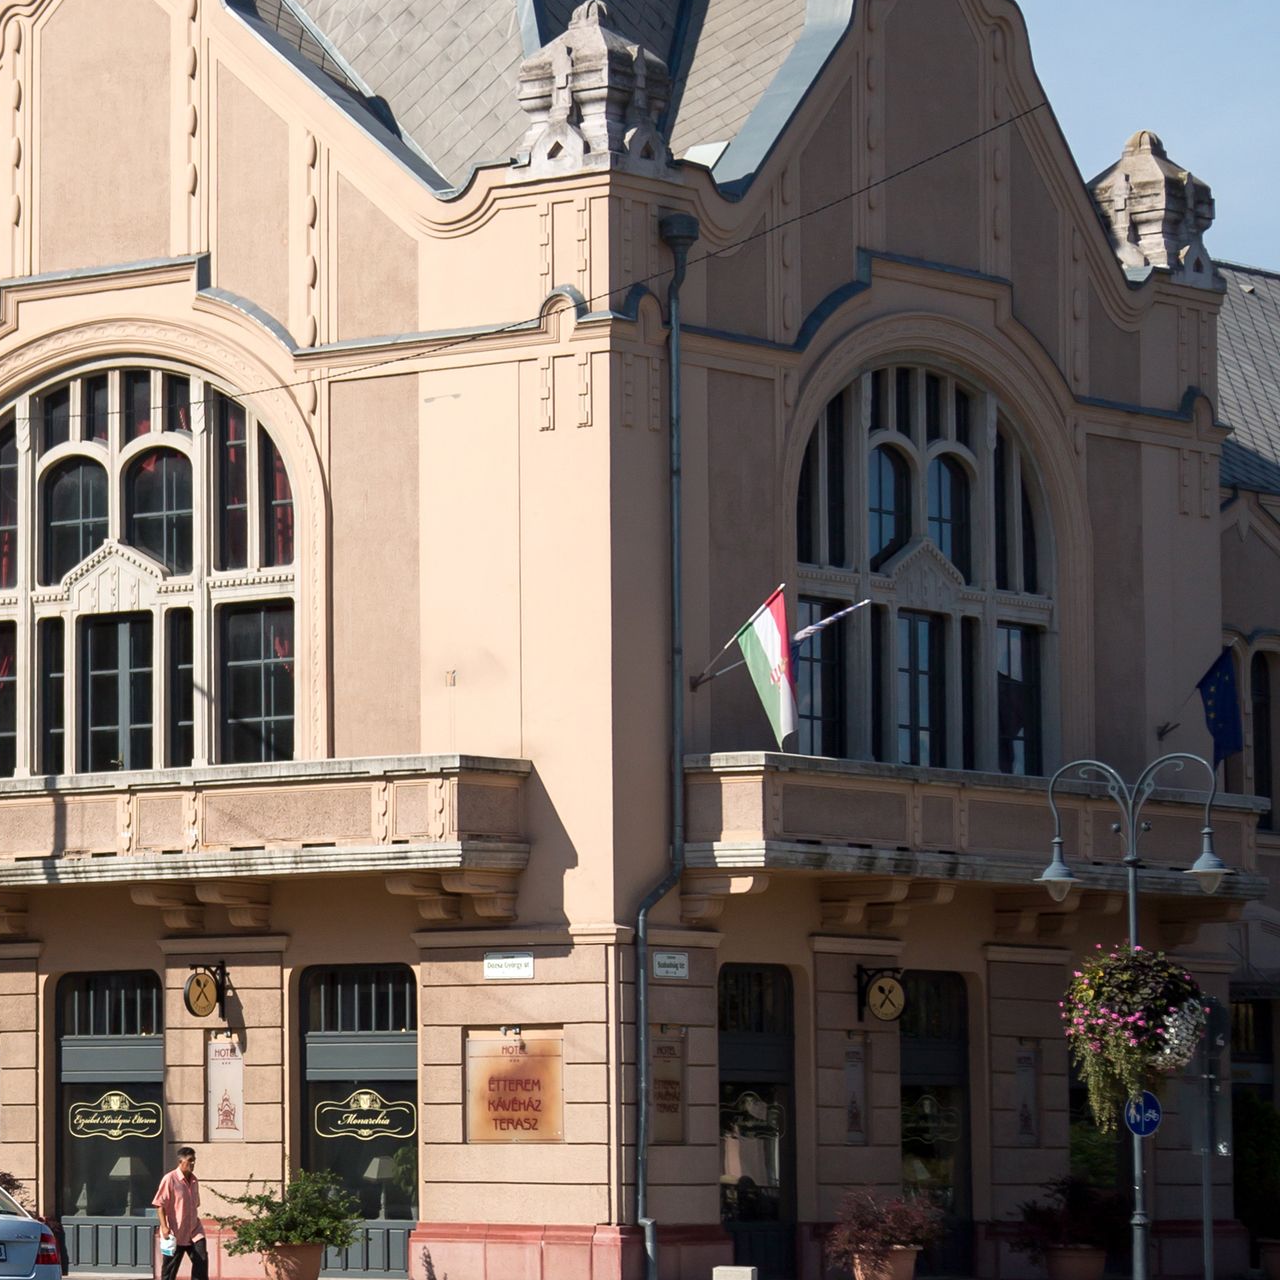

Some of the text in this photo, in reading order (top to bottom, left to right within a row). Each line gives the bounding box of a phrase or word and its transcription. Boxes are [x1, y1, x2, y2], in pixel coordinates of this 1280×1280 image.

[488, 1076, 541, 1092] ÉTTEREM
[488, 1097, 542, 1112] KÁVÉHÁZ
[337, 1110, 390, 1125] Monarchia
[493, 1118, 539, 1130] TERASZ
